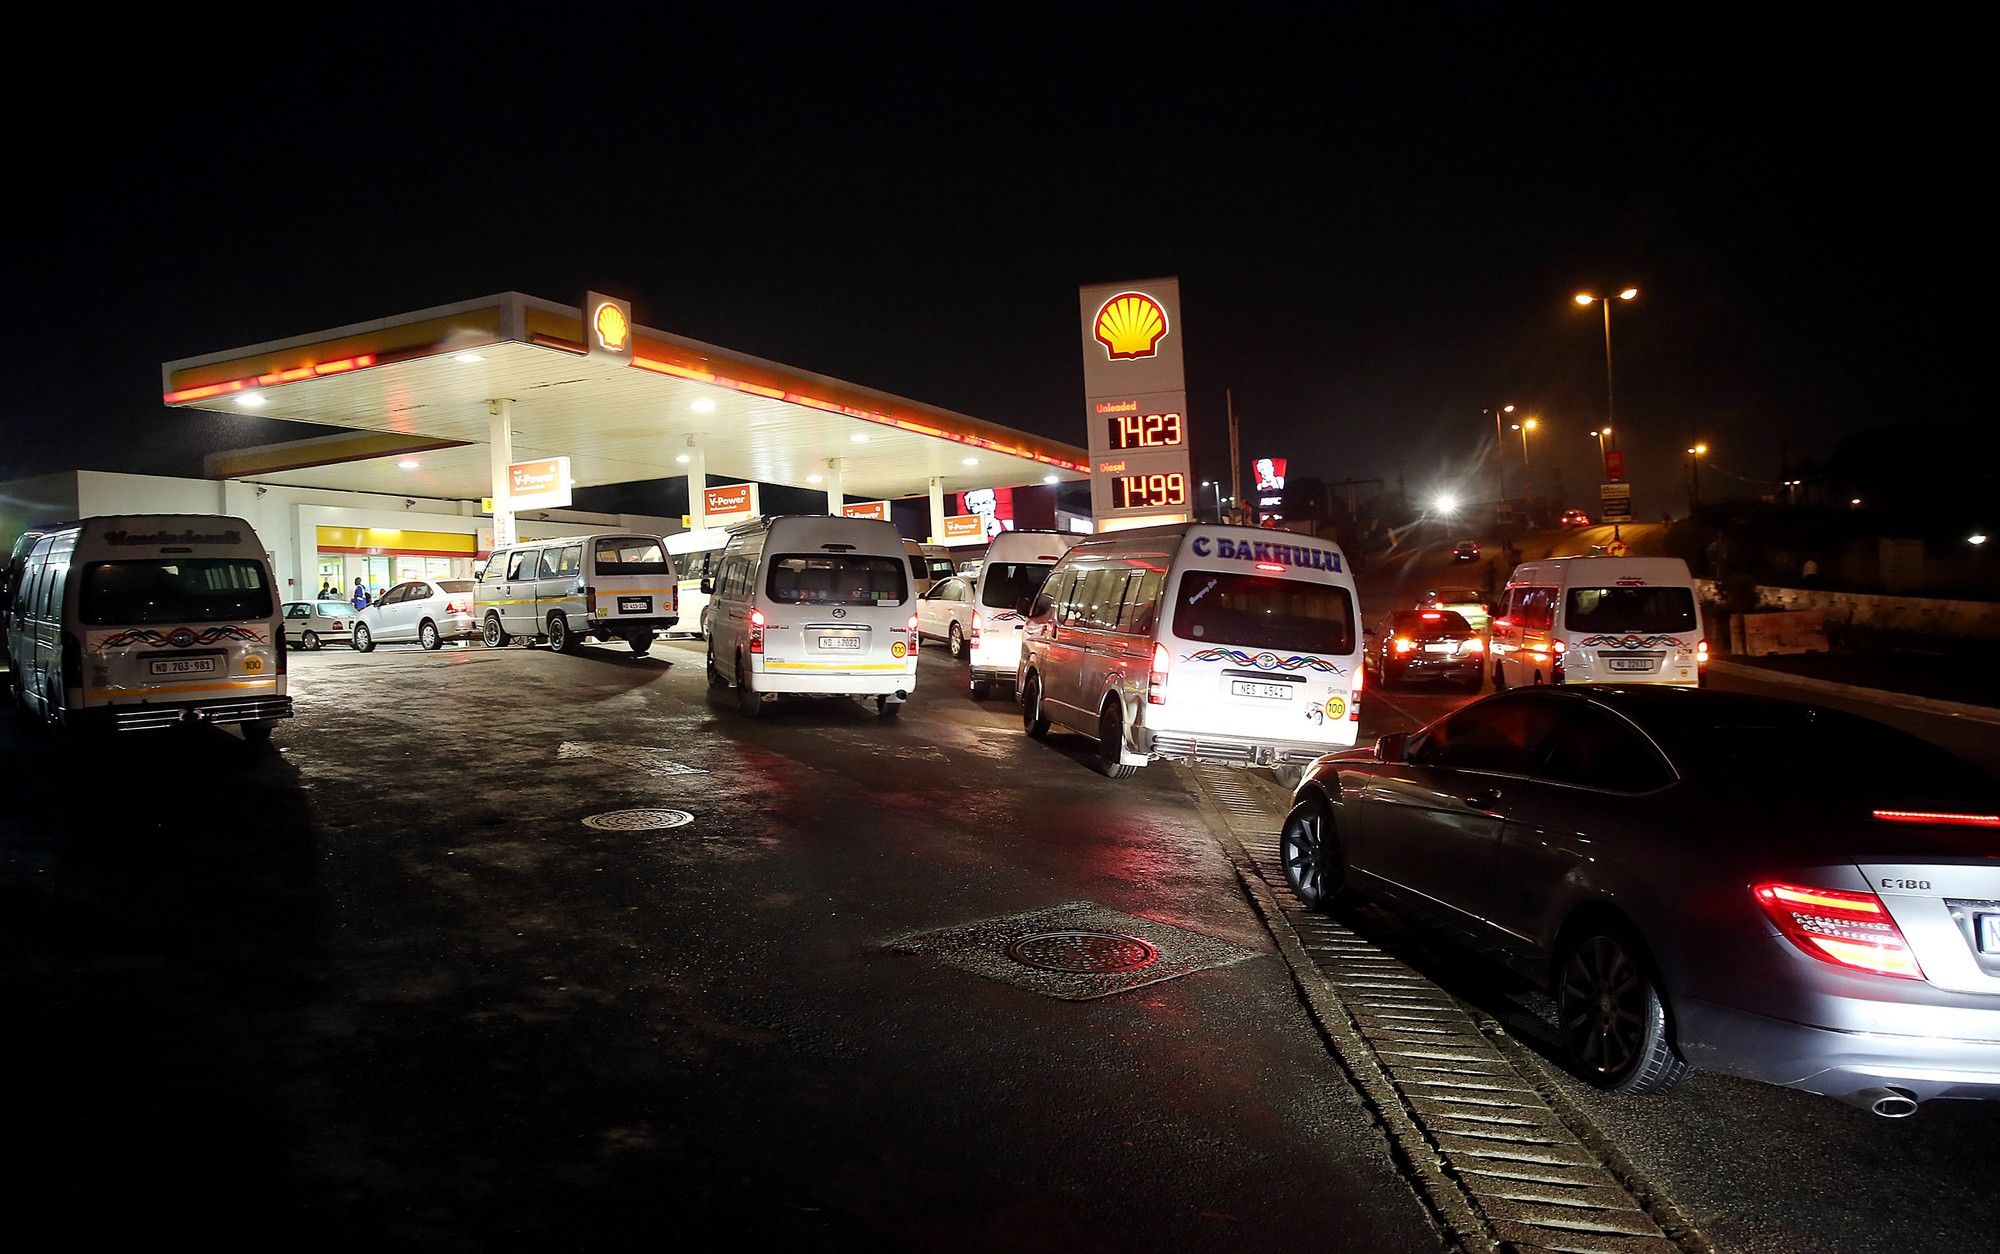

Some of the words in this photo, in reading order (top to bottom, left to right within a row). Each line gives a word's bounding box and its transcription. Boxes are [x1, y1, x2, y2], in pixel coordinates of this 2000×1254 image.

[1096, 401, 1137, 413] Unleaded
[1100, 461, 1125, 472] Diesel
[709, 496, 745, 507] V-Power
[1192, 536, 1212, 557] C
[1216, 537, 1342, 573] BAKHULU
[172, 660, 210, 671] 703-981
[244, 658, 262, 670] 100
[1241, 684, 1256, 695] NES
[1328, 703, 1343, 714] 100
